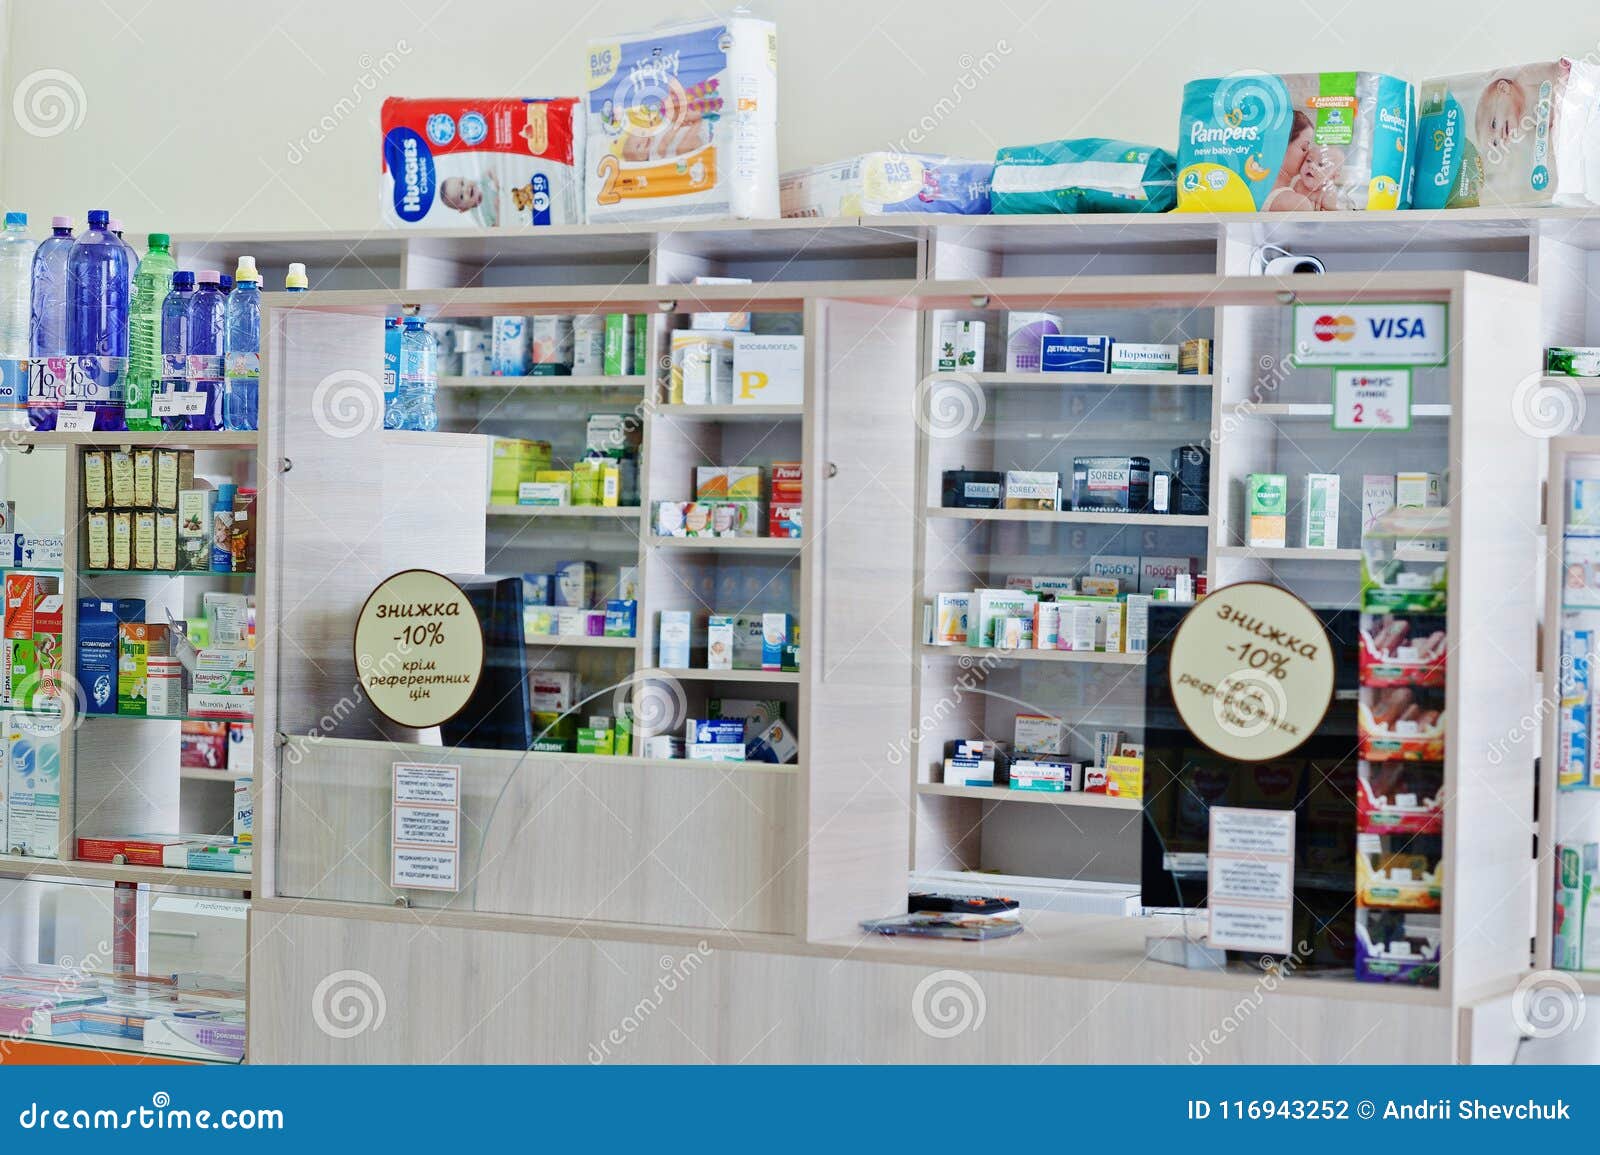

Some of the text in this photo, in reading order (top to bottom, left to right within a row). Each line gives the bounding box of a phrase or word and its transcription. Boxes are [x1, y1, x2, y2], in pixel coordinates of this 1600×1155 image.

[591, 51, 612, 68] BIG
[1190, 120, 1259, 145] Pampers
[1434, 109, 1458, 187] Pampers
[403, 138, 421, 212] HUGGIES
[419, 157, 427, 194] Classic
[597, 155, 621, 205] 2
[1369, 318, 1426, 339] VISA
[1047, 345, 1087, 353] ДЕТРАЛЕКС
[1119, 349, 1171, 361] Нормовен
[1353, 403, 1364, 423] 2
[1090, 470, 1125, 481] SORBEX
[966, 485, 997, 493] SORBEX
[376, 602, 460, 619] знижка
[393, 622, 445, 647] -10%
[1217, 604, 1319, 661] знижка
[402, 659, 436, 671] крім
[1226, 642, 1290, 680] -10%
[370, 674, 470, 688] референтних
[409, 687, 431, 701] цін
